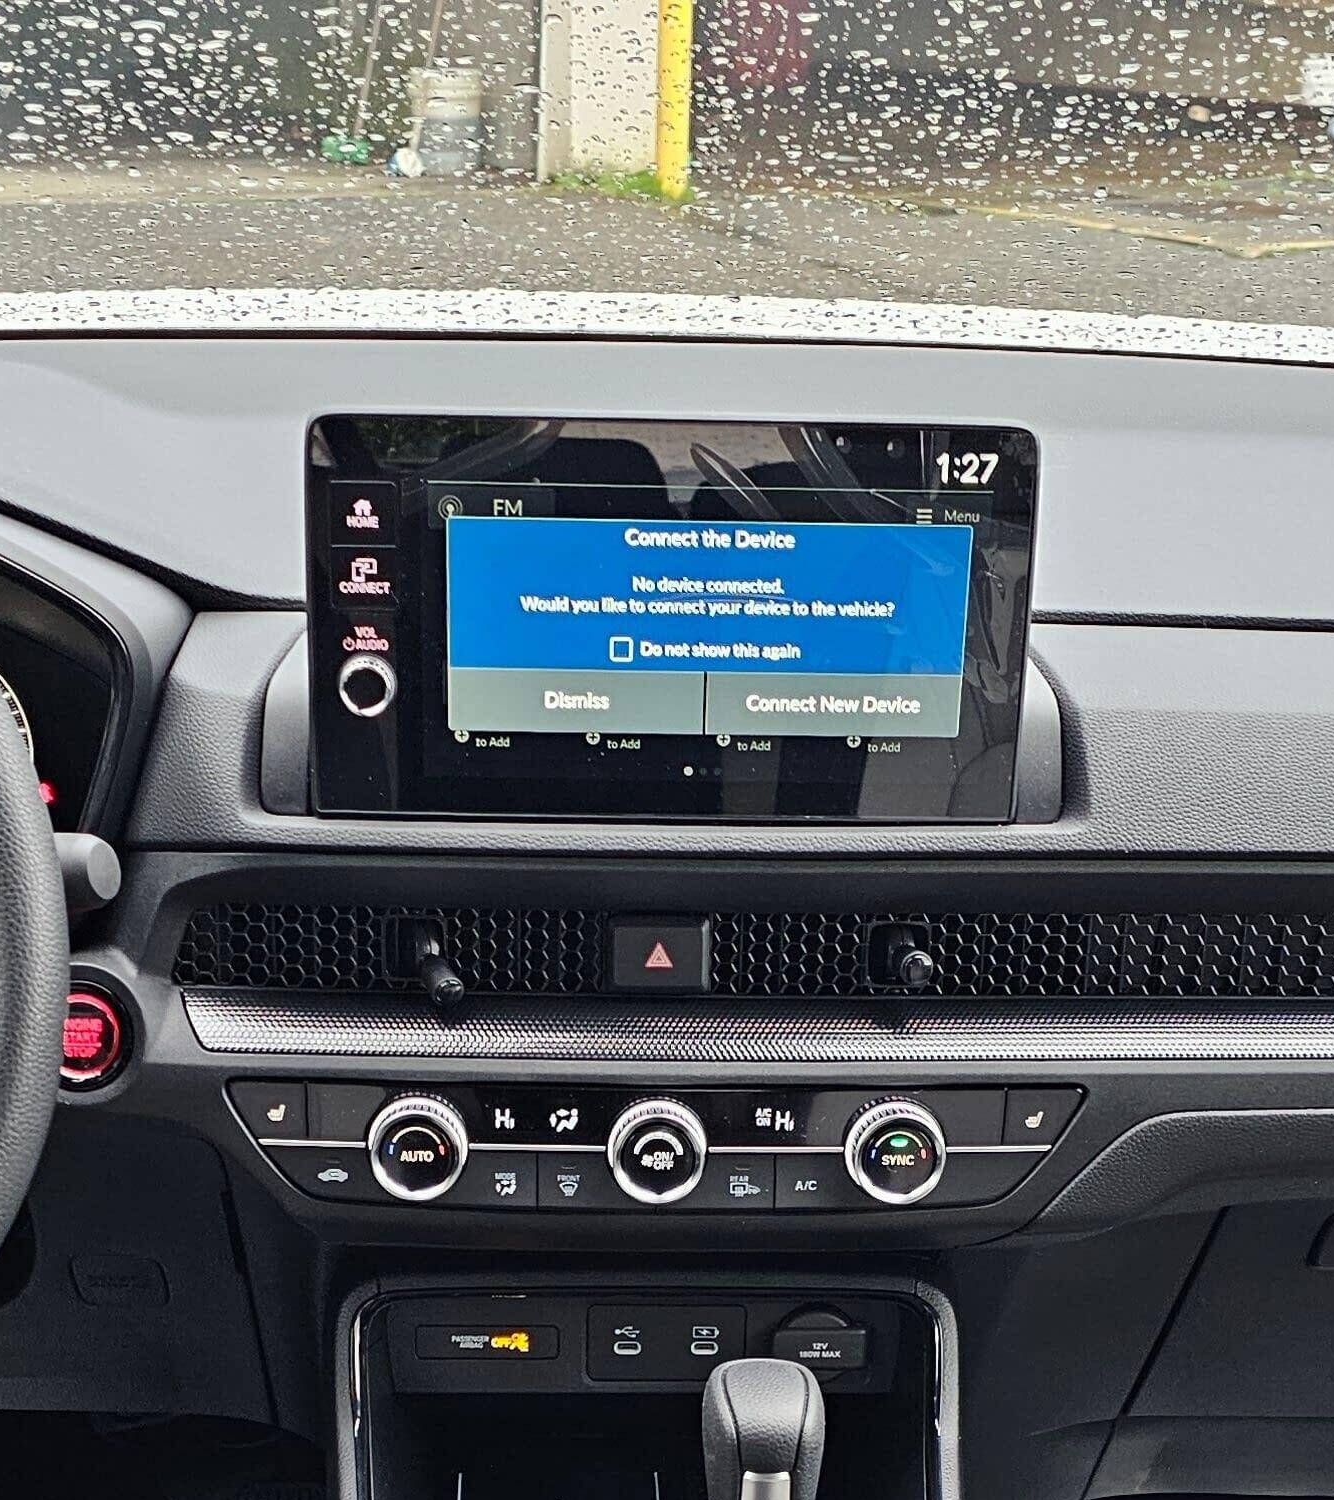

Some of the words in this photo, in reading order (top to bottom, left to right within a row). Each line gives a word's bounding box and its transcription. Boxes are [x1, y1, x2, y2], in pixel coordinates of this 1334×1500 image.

[936, 452, 1000, 485] 1:27
[493, 499, 523, 517] FM
[944, 509, 980, 523] Menu
[346, 516, 380, 529] HOME
[624, 528, 699, 548] Connect
[701, 529, 731, 548] the
[735, 530, 796, 549] Device
[339, 581, 390, 594] CONNECT
[632, 576, 655, 592] No
[657, 577, 704, 593] device
[705, 578, 784, 594] connected.
[519, 596, 570, 613] Would
[571, 599, 599, 615] you
[601, 598, 627, 613] like
[629, 599, 645, 614] to
[647, 600, 706, 615] connect
[708, 602, 742, 617] your
[744, 600, 791, 616] device
[793, 601, 809, 616] to
[811, 601, 836, 616] the
[838, 601, 895, 617] vehicle?
[354, 626, 377, 638] VOL
[355, 638, 389, 651] AUDIO
[640, 641, 662, 657] Do
[665, 643, 690, 658] not
[691, 643, 730, 658] show
[732, 643, 760, 658] this
[762, 644, 801, 661] again
[544, 691, 610, 710] Dismiss
[746, 695, 816, 713] Connect
[820, 696, 860, 713] New
[863, 696, 921, 714] Device
[476, 738, 487, 748] to
[489, 737, 509, 748] Add
[607, 740, 618, 750] to
[620, 739, 640, 750] Add
[738, 741, 749, 751] to
[751, 740, 771, 751] Add
[868, 743, 879, 753] to
[881, 742, 901, 753] Add
[755, 1108, 772, 1117] A/C
[756, 1117, 771, 1127] ON
[400, 1150, 435, 1163] AUTO
[653, 1151, 674, 1161] ON/
[881, 1154, 915, 1166] SYNC
[653, 1160, 674, 1170] OFF
[557, 1174, 581, 1182] FRONT
[730, 1176, 749, 1184] REAR
[795, 1180, 818, 1191] A/C
[812, 1342, 828, 1350] 12V
